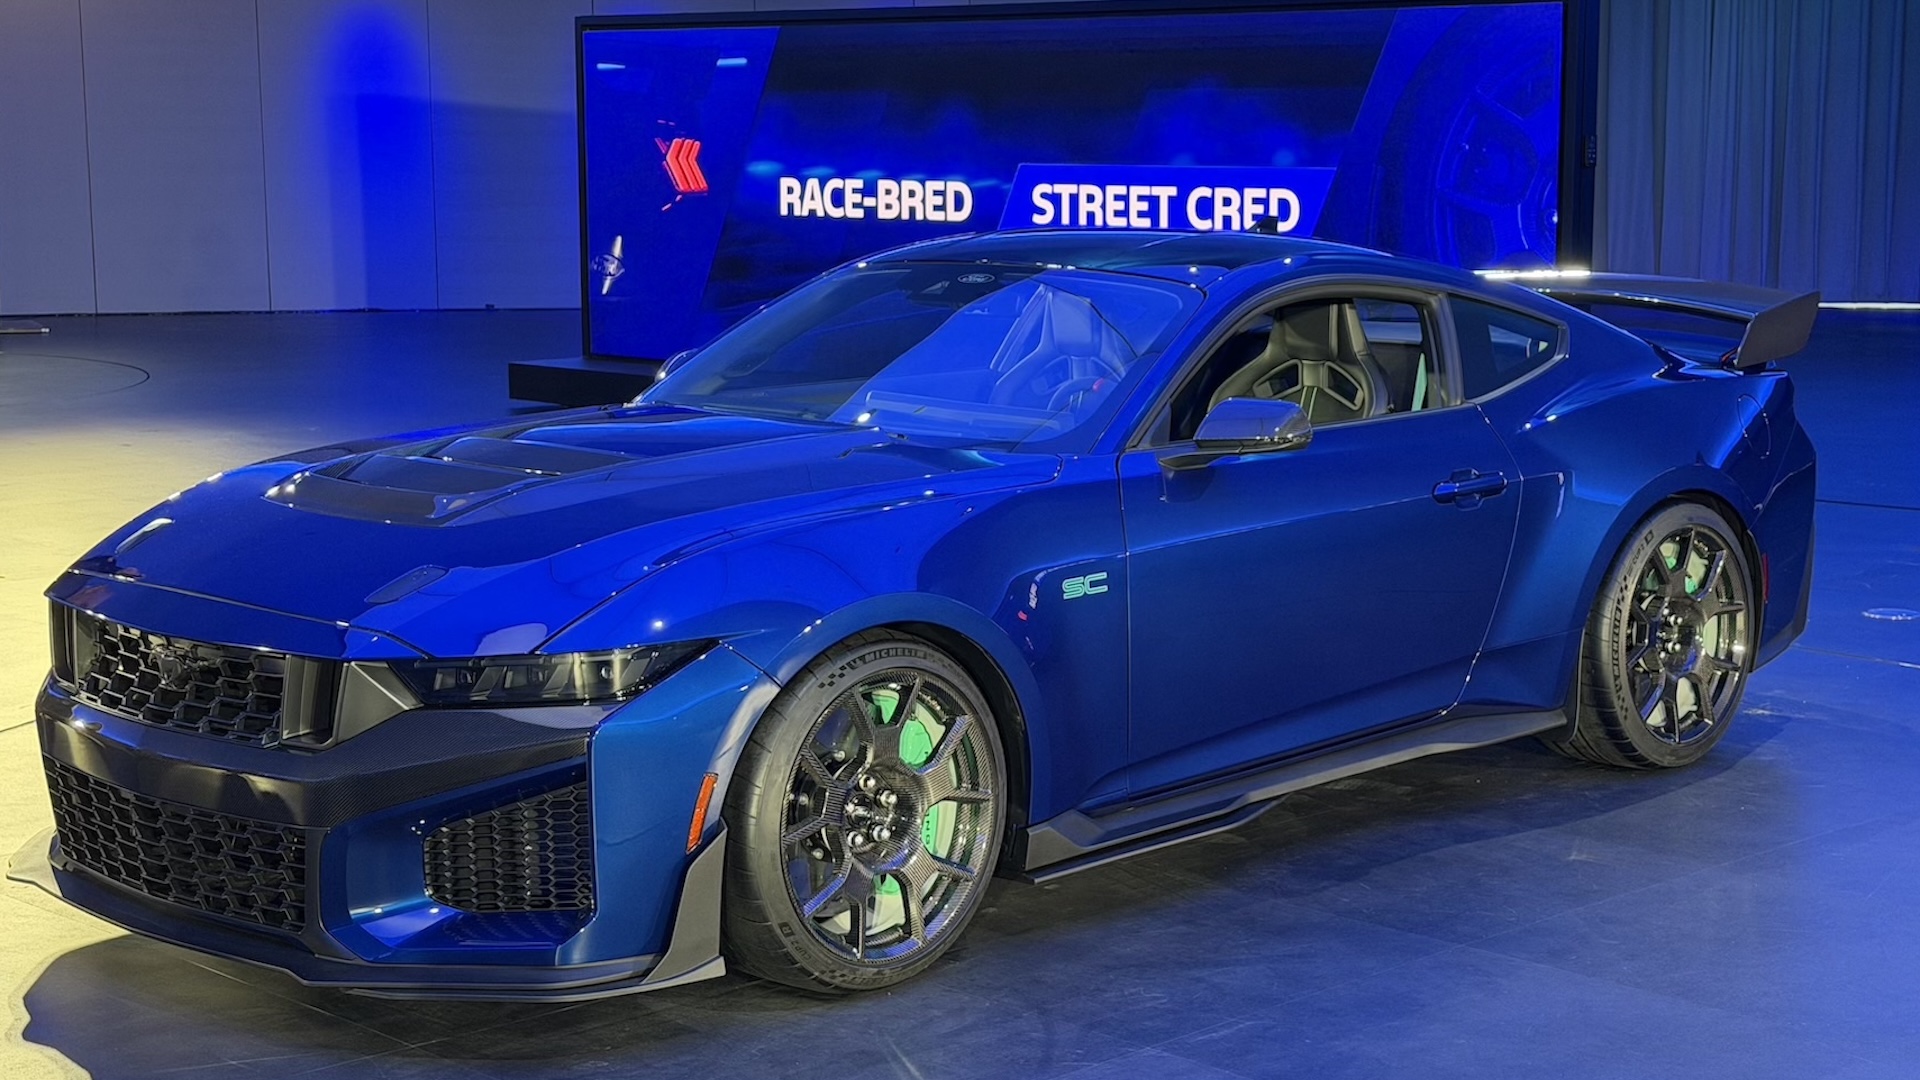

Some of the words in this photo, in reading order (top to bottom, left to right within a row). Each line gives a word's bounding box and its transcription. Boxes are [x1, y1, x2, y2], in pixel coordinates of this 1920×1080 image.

[779, 177, 973, 222] RACE-BRED
[1031, 183, 1177, 229] STREET
[1186, 186, 1300, 232] CRED
[1062, 571, 1109, 600] SC
[863, 647, 928, 663] MICHELIN
[1612, 607, 1621, 677] MICHELIN
